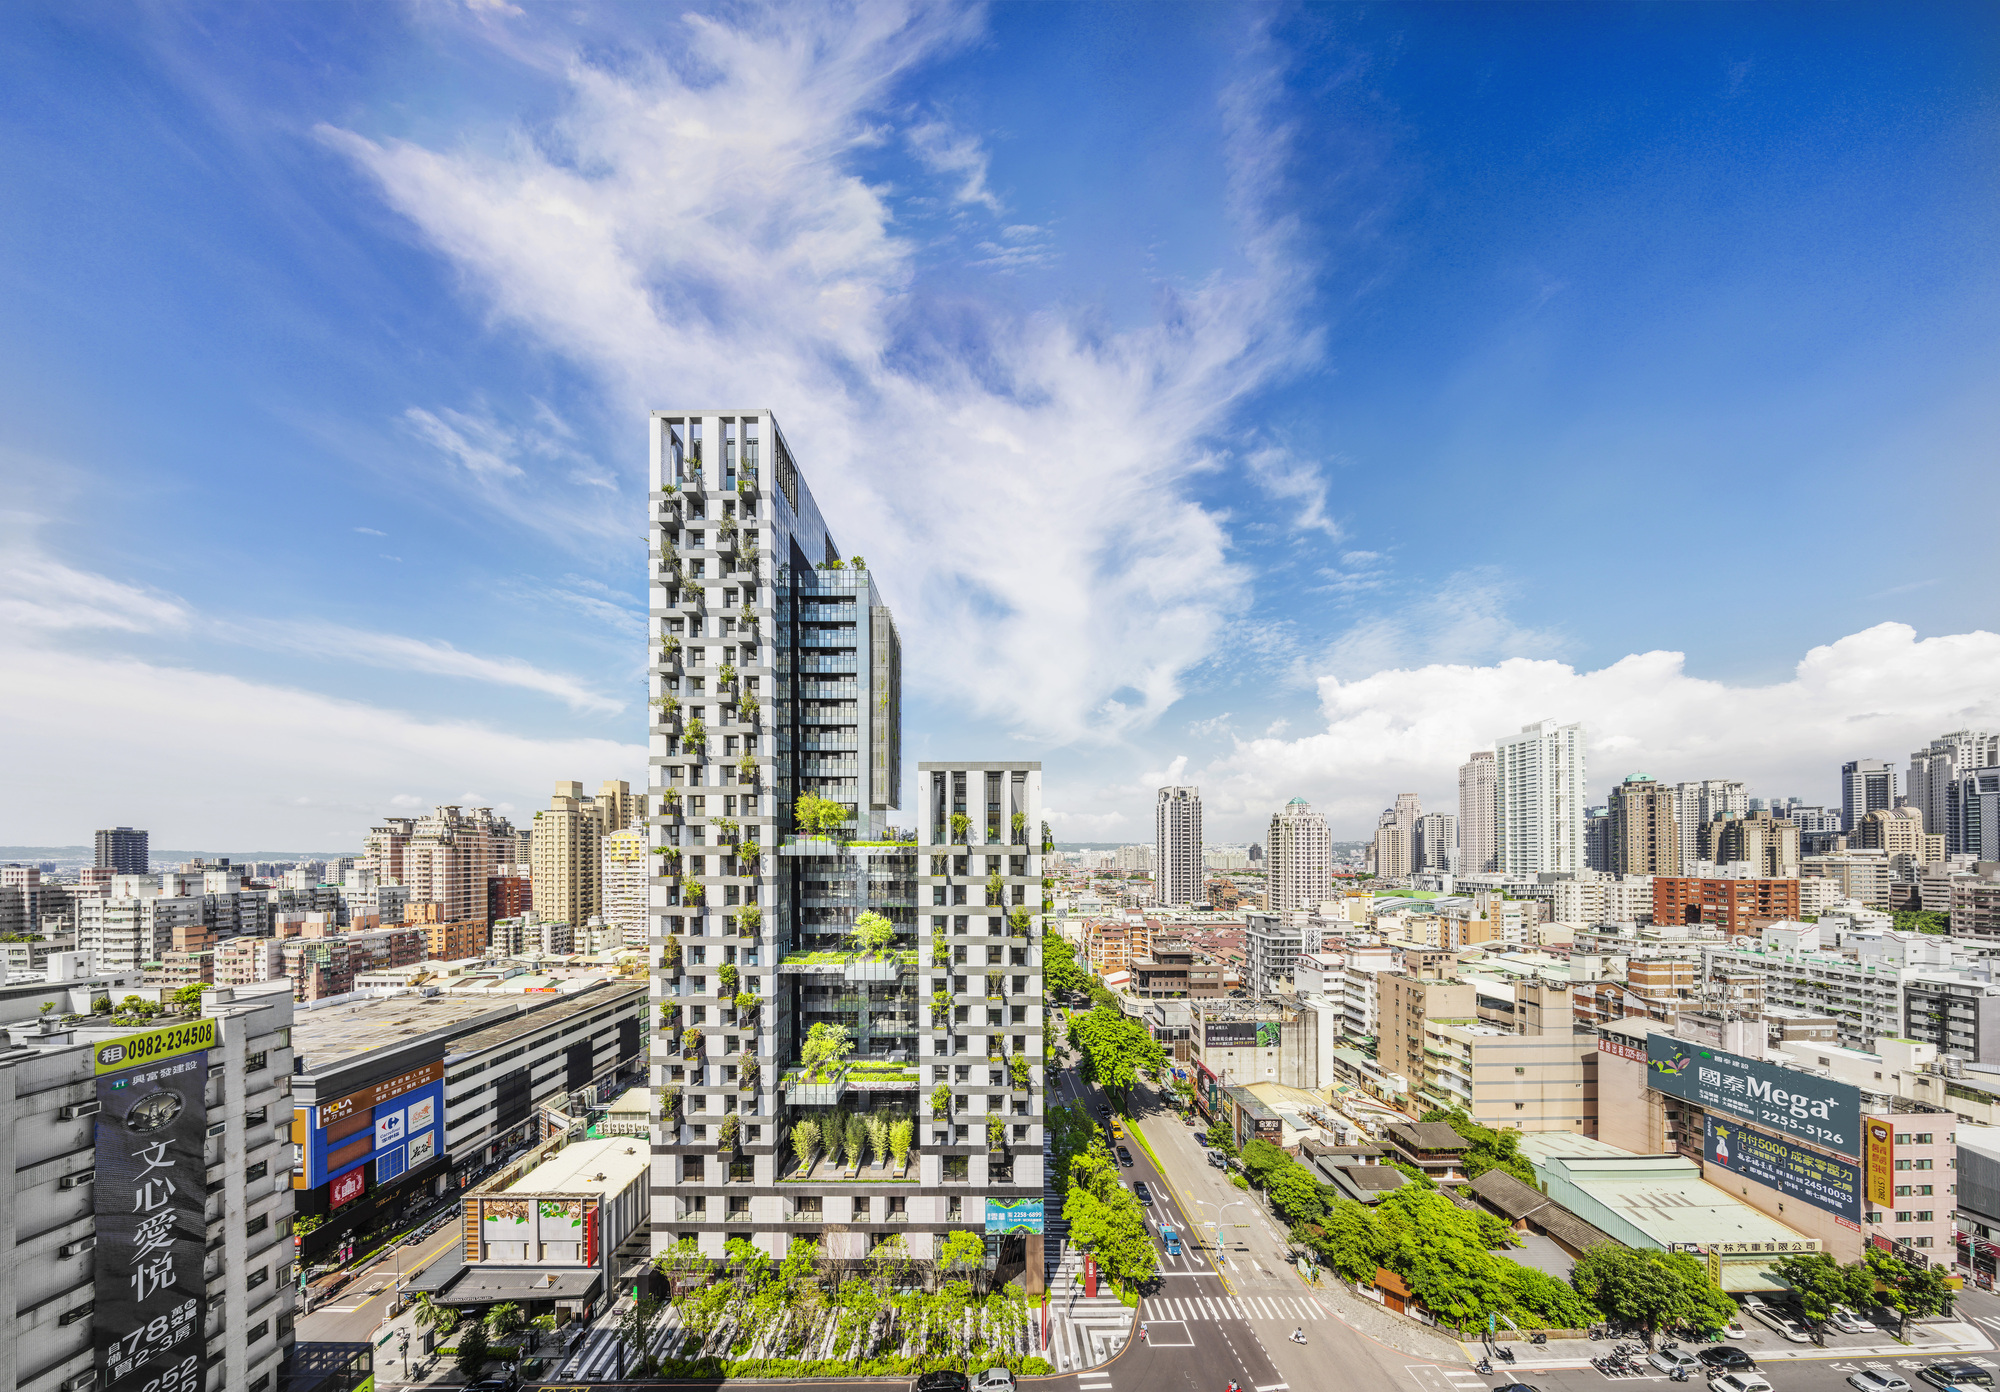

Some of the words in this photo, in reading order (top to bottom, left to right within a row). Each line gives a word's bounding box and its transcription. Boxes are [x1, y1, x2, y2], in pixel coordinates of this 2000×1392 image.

[102, 1046, 123, 1063] 租
[128, 1024, 212, 1060] 0982-234508
[132, 1061, 197, 1086] 興富發建設
[1714, 1055, 1749, 1070] 國泰建設
[322, 1098, 353, 1116] HOLA
[1761, 1109, 1844, 1145] 2255-5126
[1737, 1131, 1788, 1158] 月付5000
[1790, 1151, 1853, 1182] 成家零壓力
[1804, 1178, 1853, 1204] 24510033
[129, 1138, 178, 1303] 文心愛悅
[122, 1315, 169, 1356] 78
